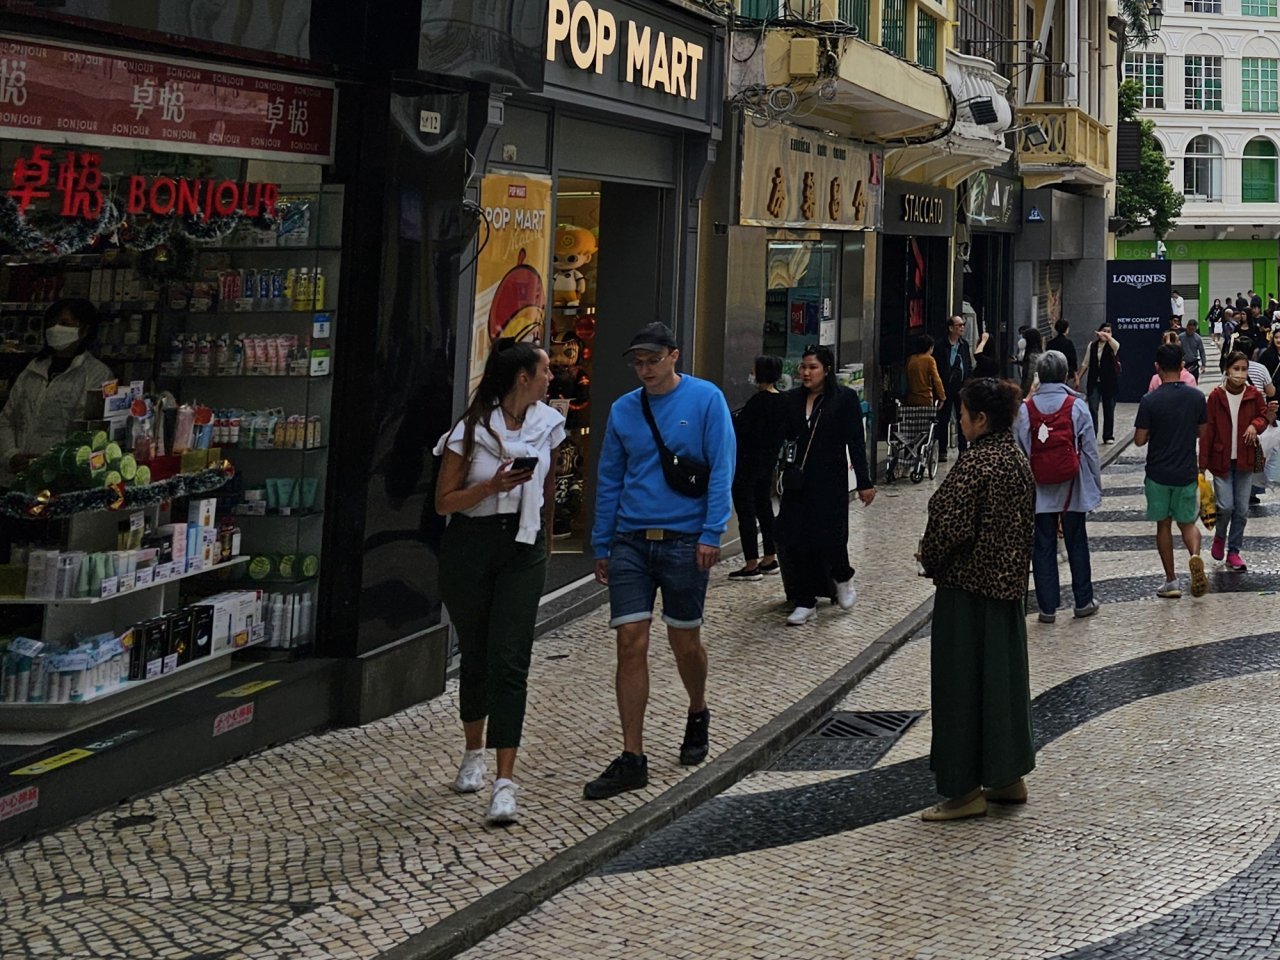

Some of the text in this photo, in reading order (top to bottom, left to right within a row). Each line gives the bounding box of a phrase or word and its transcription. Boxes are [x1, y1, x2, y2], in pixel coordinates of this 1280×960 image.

[118, 59, 153, 73] BONJOUR
[167, 66, 200, 80] BONJOUR
[213, 73, 244, 87] BONJOUR
[255, 80, 284, 91] BONJOUR
[626, 20, 703, 101] MART
[57, 118, 98, 131] BONJOUR
[112, 123, 149, 136] BONJOUR
[163, 128, 197, 140] BONJOUR
[208, 132, 240, 145] BONJOUR
[251, 137, 281, 148] BONJOUR
[430, 115, 438, 131] 12
[128, 175, 281, 224] BONJOUR
[508, 186, 517, 196] POP
[485, 206, 546, 231] POP MART
[904, 193, 943, 225] STACCATO
[1113, 274, 1167, 283] LONGINES
